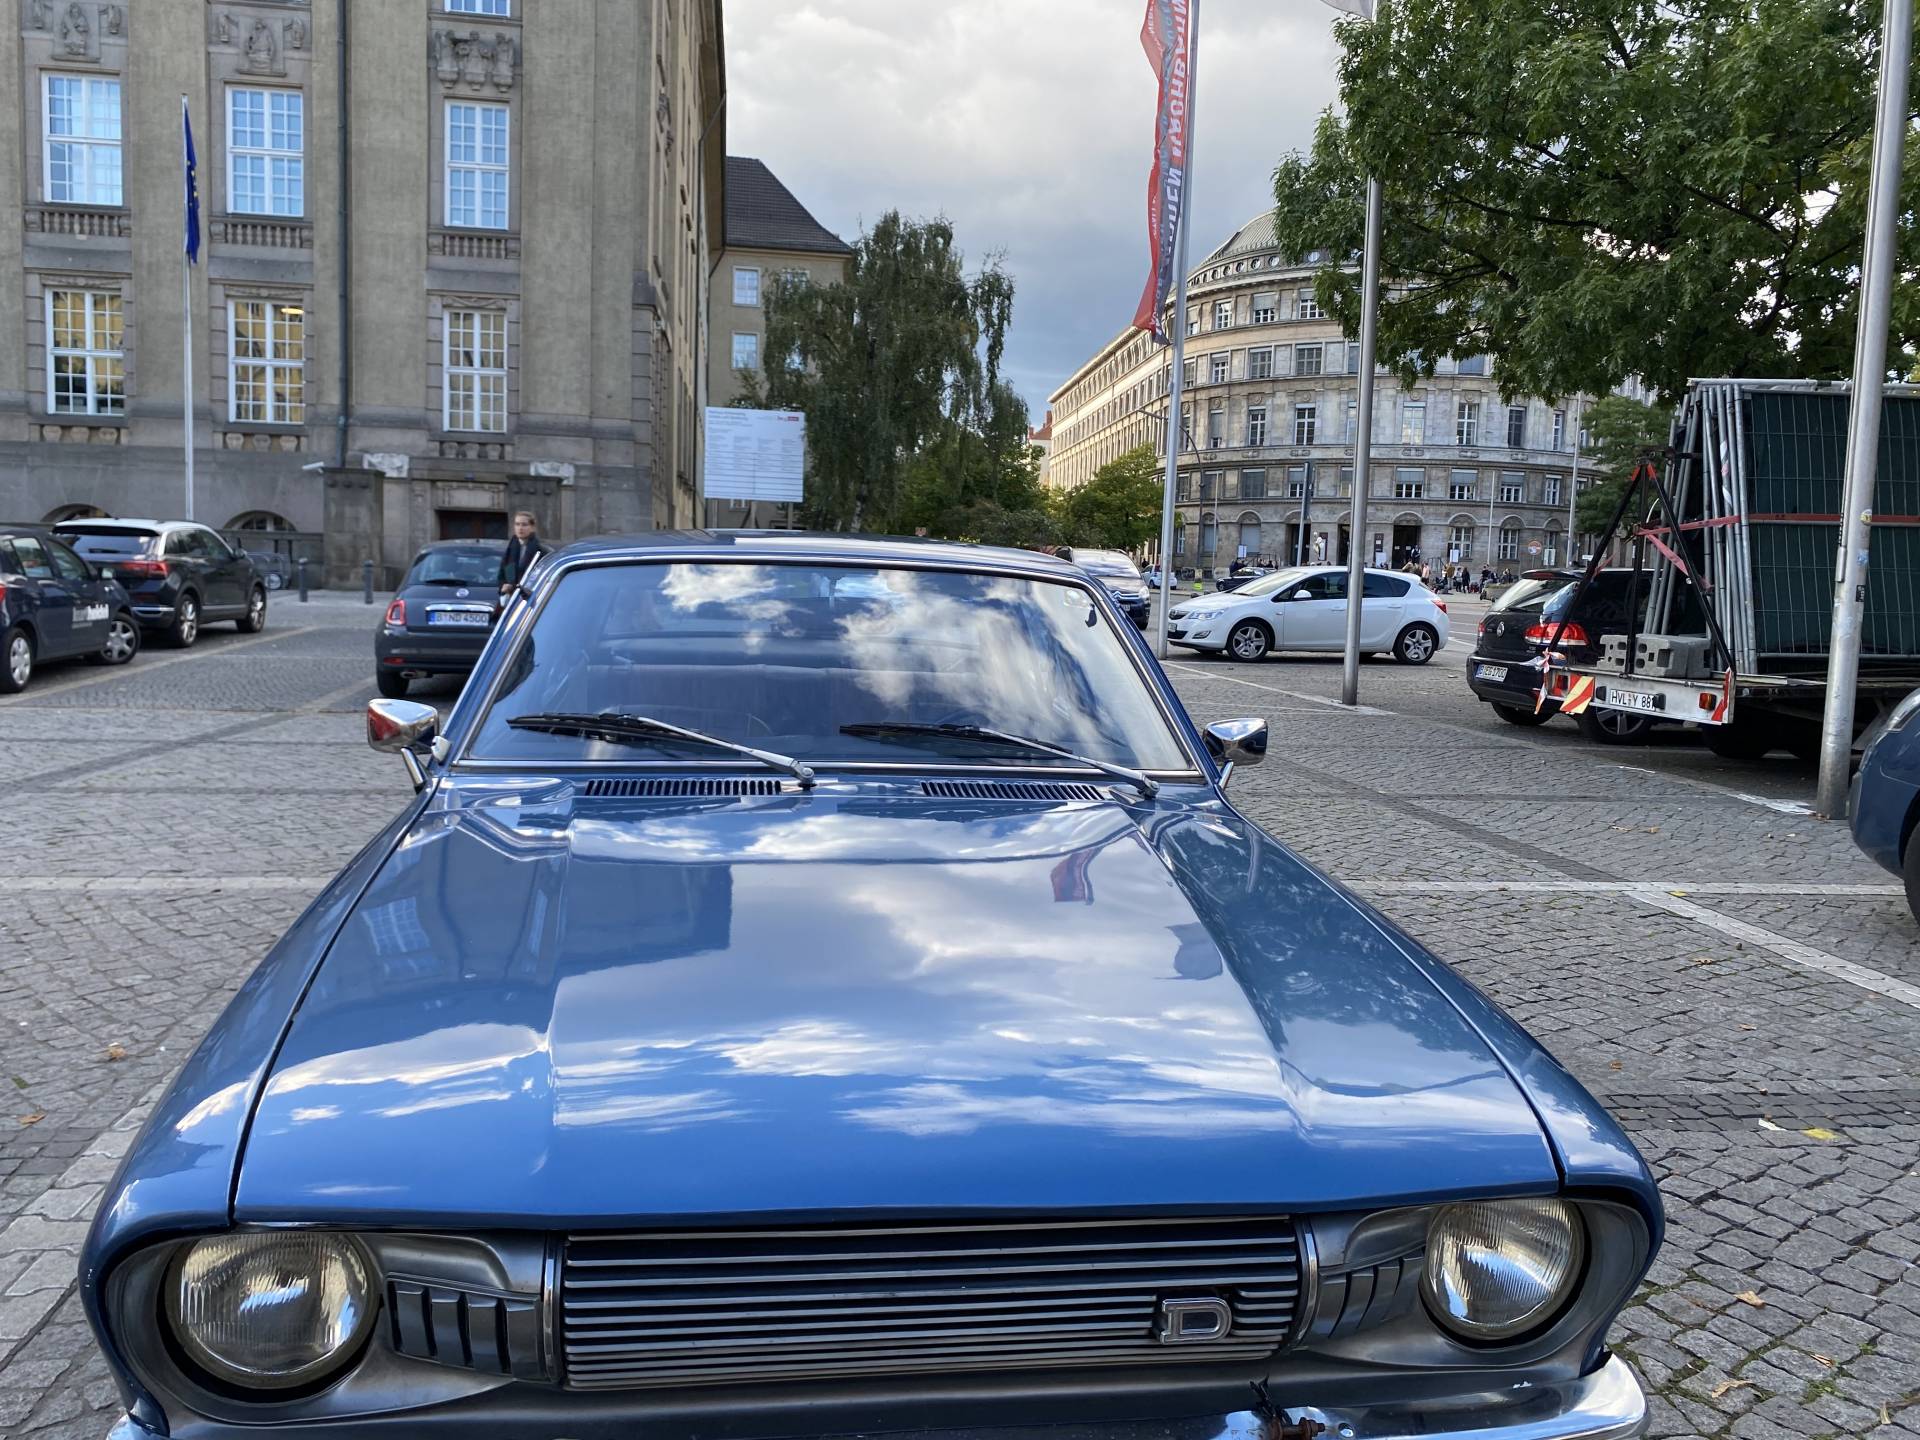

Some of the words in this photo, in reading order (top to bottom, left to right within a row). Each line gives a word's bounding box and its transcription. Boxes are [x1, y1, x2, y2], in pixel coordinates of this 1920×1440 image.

[1611, 690, 1627, 705] HVL
[1632, 694, 1638, 706] Y
[1161, 1297, 1232, 1345] D
